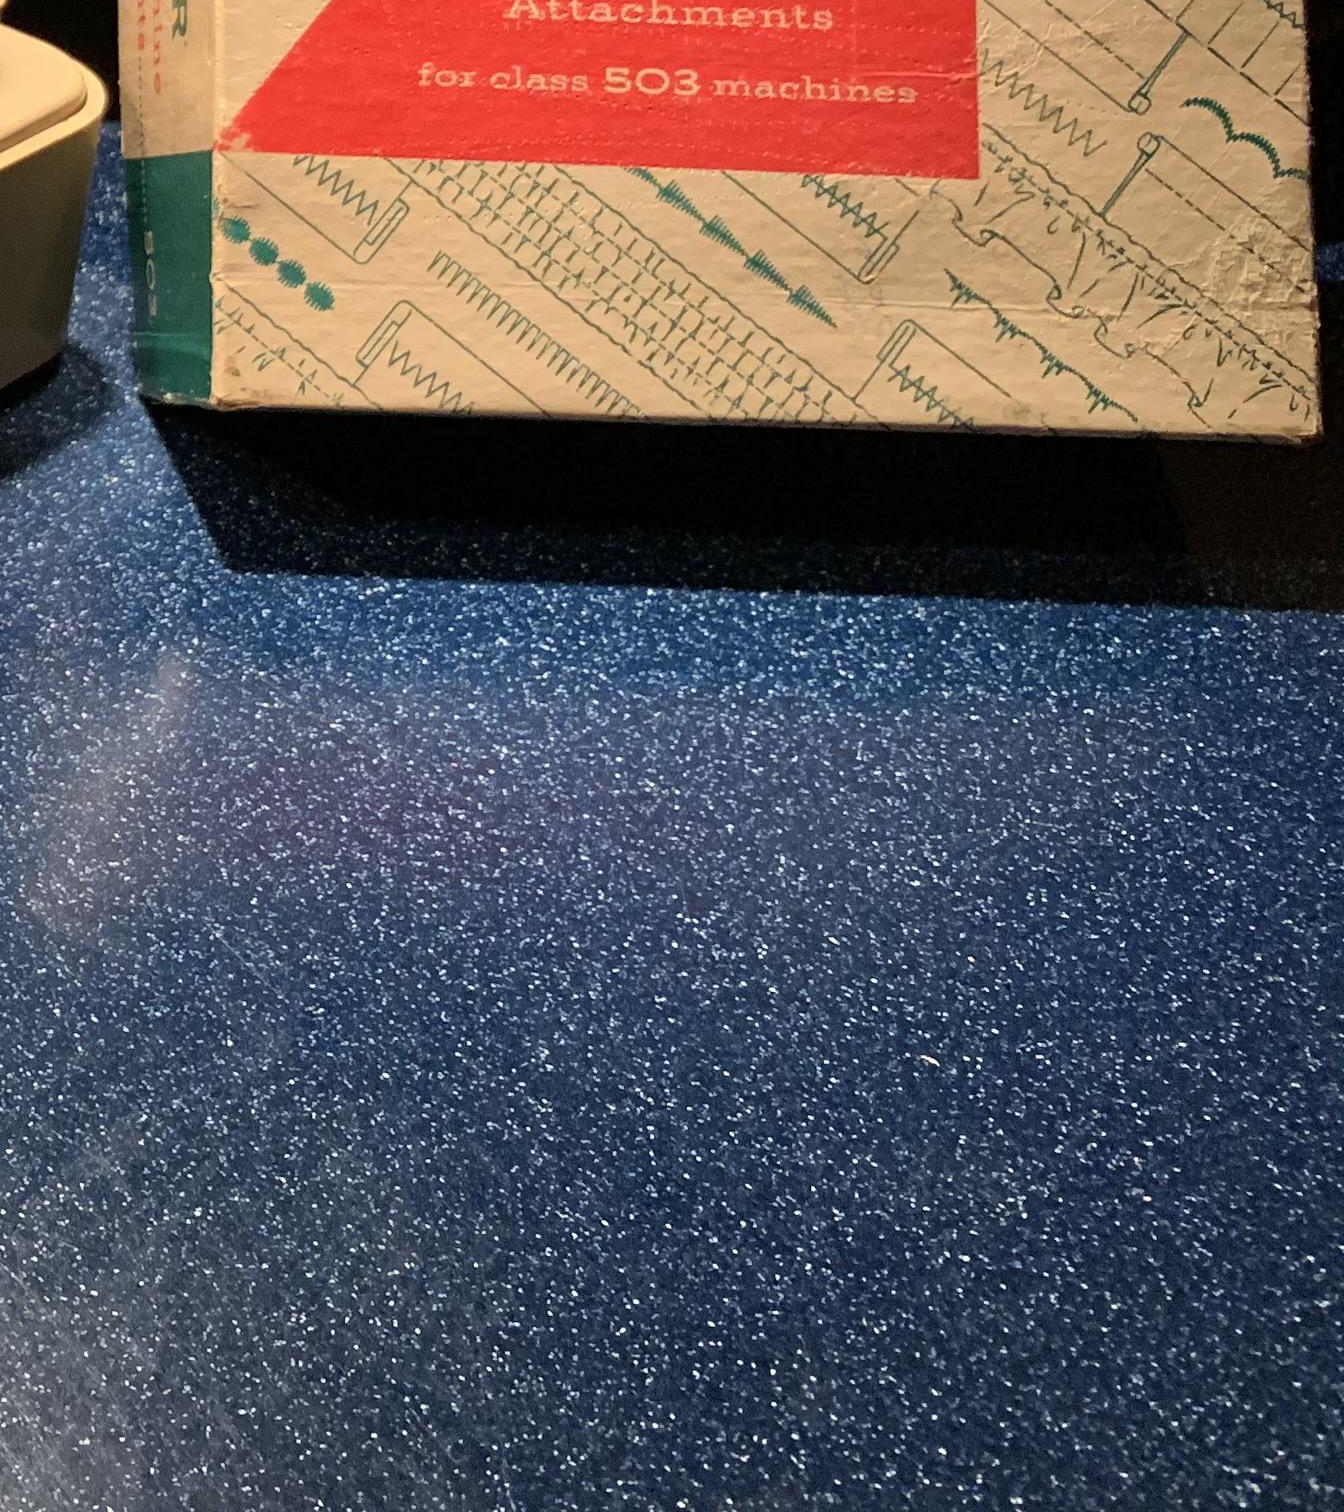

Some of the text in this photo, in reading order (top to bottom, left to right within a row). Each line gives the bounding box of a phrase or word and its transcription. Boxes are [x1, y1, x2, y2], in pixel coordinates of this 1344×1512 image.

[416, 61, 918, 105] for class 503 machines
